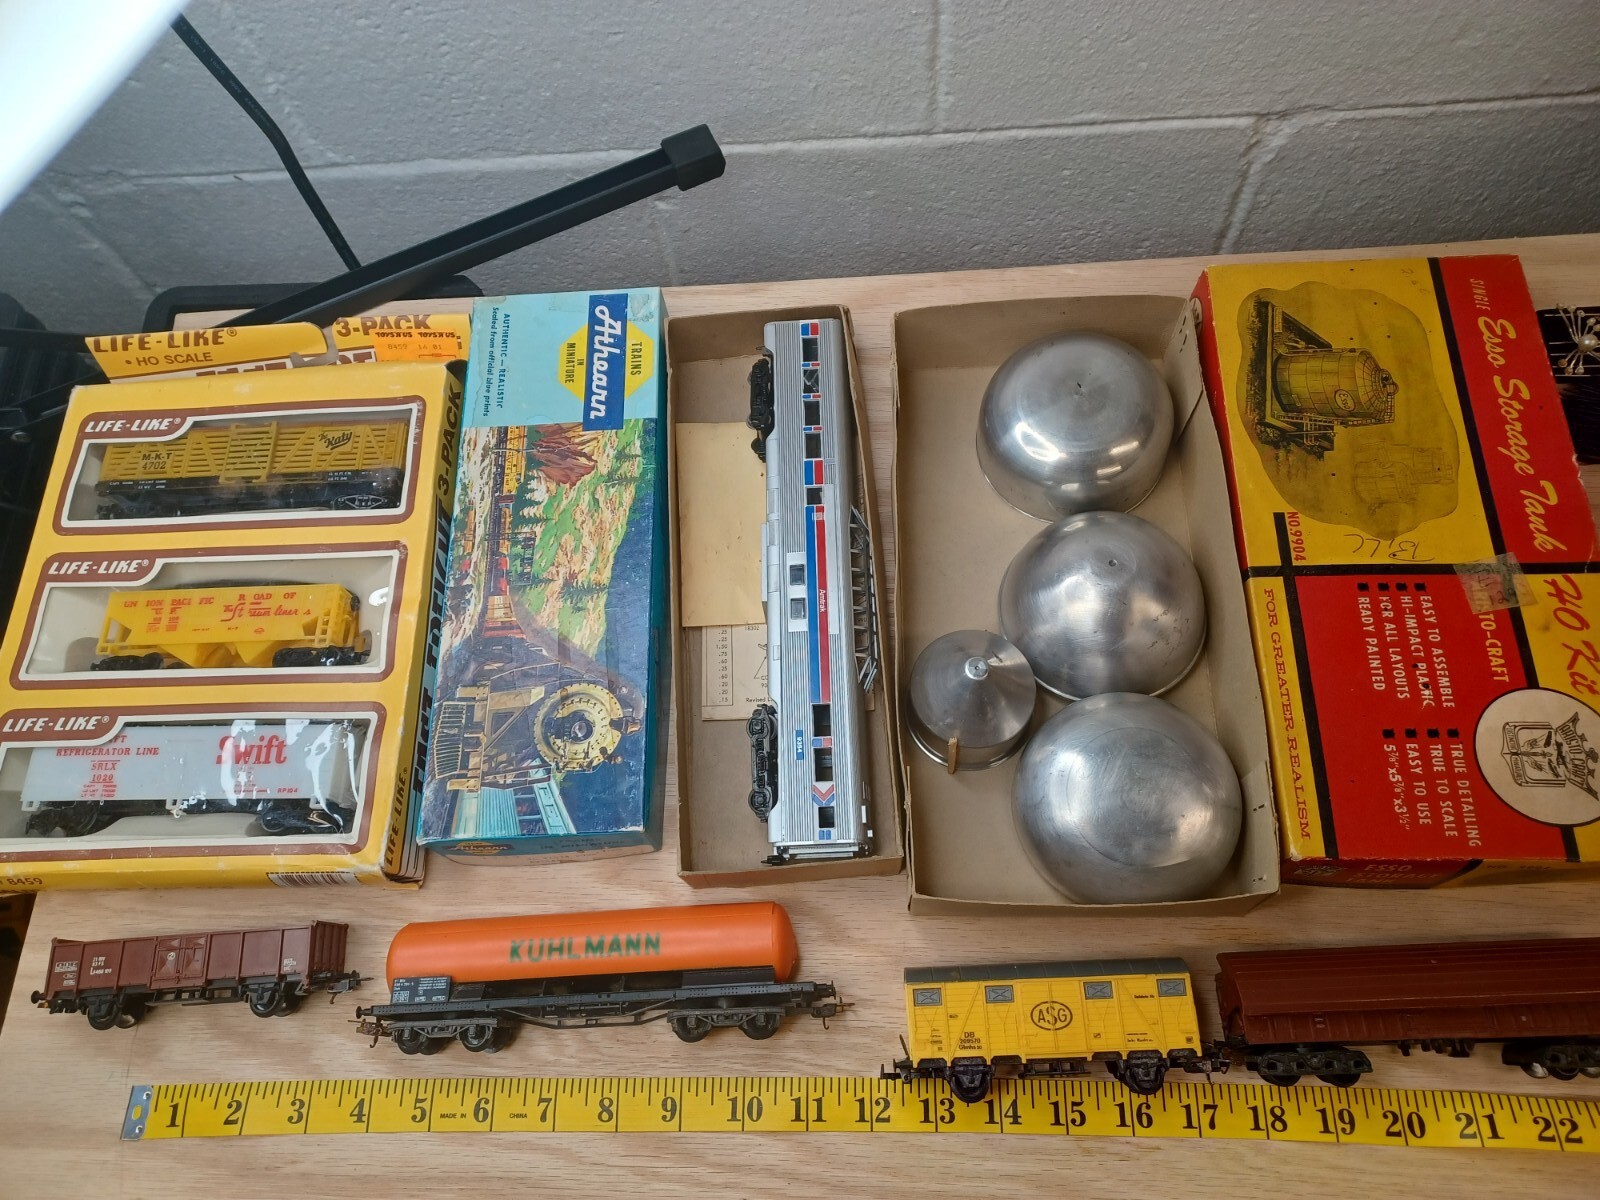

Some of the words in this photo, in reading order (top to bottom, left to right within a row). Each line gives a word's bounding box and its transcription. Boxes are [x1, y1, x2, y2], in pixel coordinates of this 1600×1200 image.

[1469, 278, 1491, 311] SINGLE
[335, 313, 432, 338] 3-PACK
[490, 306, 499, 330] Scaled
[489, 330, 498, 349] from
[500, 313, 511, 358] AUTHENTIC
[1477, 316, 1517, 369] Esso
[136, 356, 160, 366] HO
[164, 351, 214, 364] SCALE
[487, 349, 496, 375] official
[564, 342, 577, 384] MINIATURE
[576, 358, 585, 366] IN
[589, 304, 622, 420] Athearn
[630, 341, 643, 377] TRAINS
[485, 375, 494, 394] blue
[496, 368, 506, 409] REALISTIC
[482, 395, 491, 417] prints
[324, 431, 353, 450] Katy
[437, 381, 461, 496] 3-PACK
[1493, 374, 1535, 476] Storage
[141, 452, 173, 461] M-K-T
[141, 460, 167, 471] 4702
[1519, 479, 1567, 553] Tank
[819, 588, 827, 613] Amtrak
[1264, 588, 1279, 628] FOR
[1357, 596, 1376, 632] READY
[1378, 596, 1394, 618] FOR
[1420, 595, 1437, 623] EASY
[1543, 575, 1591, 632] HO
[1384, 622, 1399, 642] ALL
[1427, 628, 1441, 642] TO
[1365, 637, 1386, 691] PAINTED
[1399, 595, 1424, 657] HI-IMPACT
[1414, 662, 1435, 708] PLASTIC
[1271, 631, 1295, 732] GREATER
[1388, 647, 1411, 699] LAYOUTS
[1431, 647, 1455, 708] ASSEMBLE
[1561, 640, 1600, 695] Kit
[55, 746, 131, 757] REFRIGERATOR
[135, 747, 160, 756] LINE
[215, 734, 288, 765] Swift
[1405, 743, 1423, 775] EASY
[1429, 743, 1446, 772] TRUE
[1449, 743, 1468, 774] TRUE
[1558, 723, 1586, 788] ARISTO-CRAFT
[90, 762, 118, 771] SRLX
[1287, 736, 1311, 840] REALISM
[1412, 781, 1427, 796] TO
[1436, 779, 1450, 794] TO
[1416, 802, 1432, 825] USE
[1439, 800, 1459, 837] SCALE
[1456, 780, 1482, 847] DETAILING
[6, 877, 43, 886] 8459
[509, 931, 661, 963] KUHLMANN
[1034, 1004, 1068, 1027] ASG
[165, 1102, 180, 1128] 1
[223, 1099, 243, 1126] 2
[287, 1098, 305, 1125] 3
[349, 1097, 366, 1124] 4
[410, 1097, 428, 1123] 5
[473, 1096, 490, 1123] 6
[537, 1096, 553, 1123] 7
[597, 1096, 614, 1123] 8
[660, 1096, 678, 1123] 9
[726, 1095, 763, 1123] 10
[790, 1095, 828, 1123] 11
[854, 1096, 892, 1124] 12
[919, 1097, 957, 1124] 13
[984, 1097, 1023, 1126] 14
[1048, 1100, 1087, 1128] 15
[1113, 1101, 1154, 1129] 16
[1180, 1102, 1219, 1131] 17
[1246, 1104, 1288, 1133] 18
[1315, 1107, 1356, 1136] 19
[1381, 1109, 1427, 1139] 20
[1454, 1112, 1505, 1140] 21
[1531, 1115, 1584, 1144] 22
